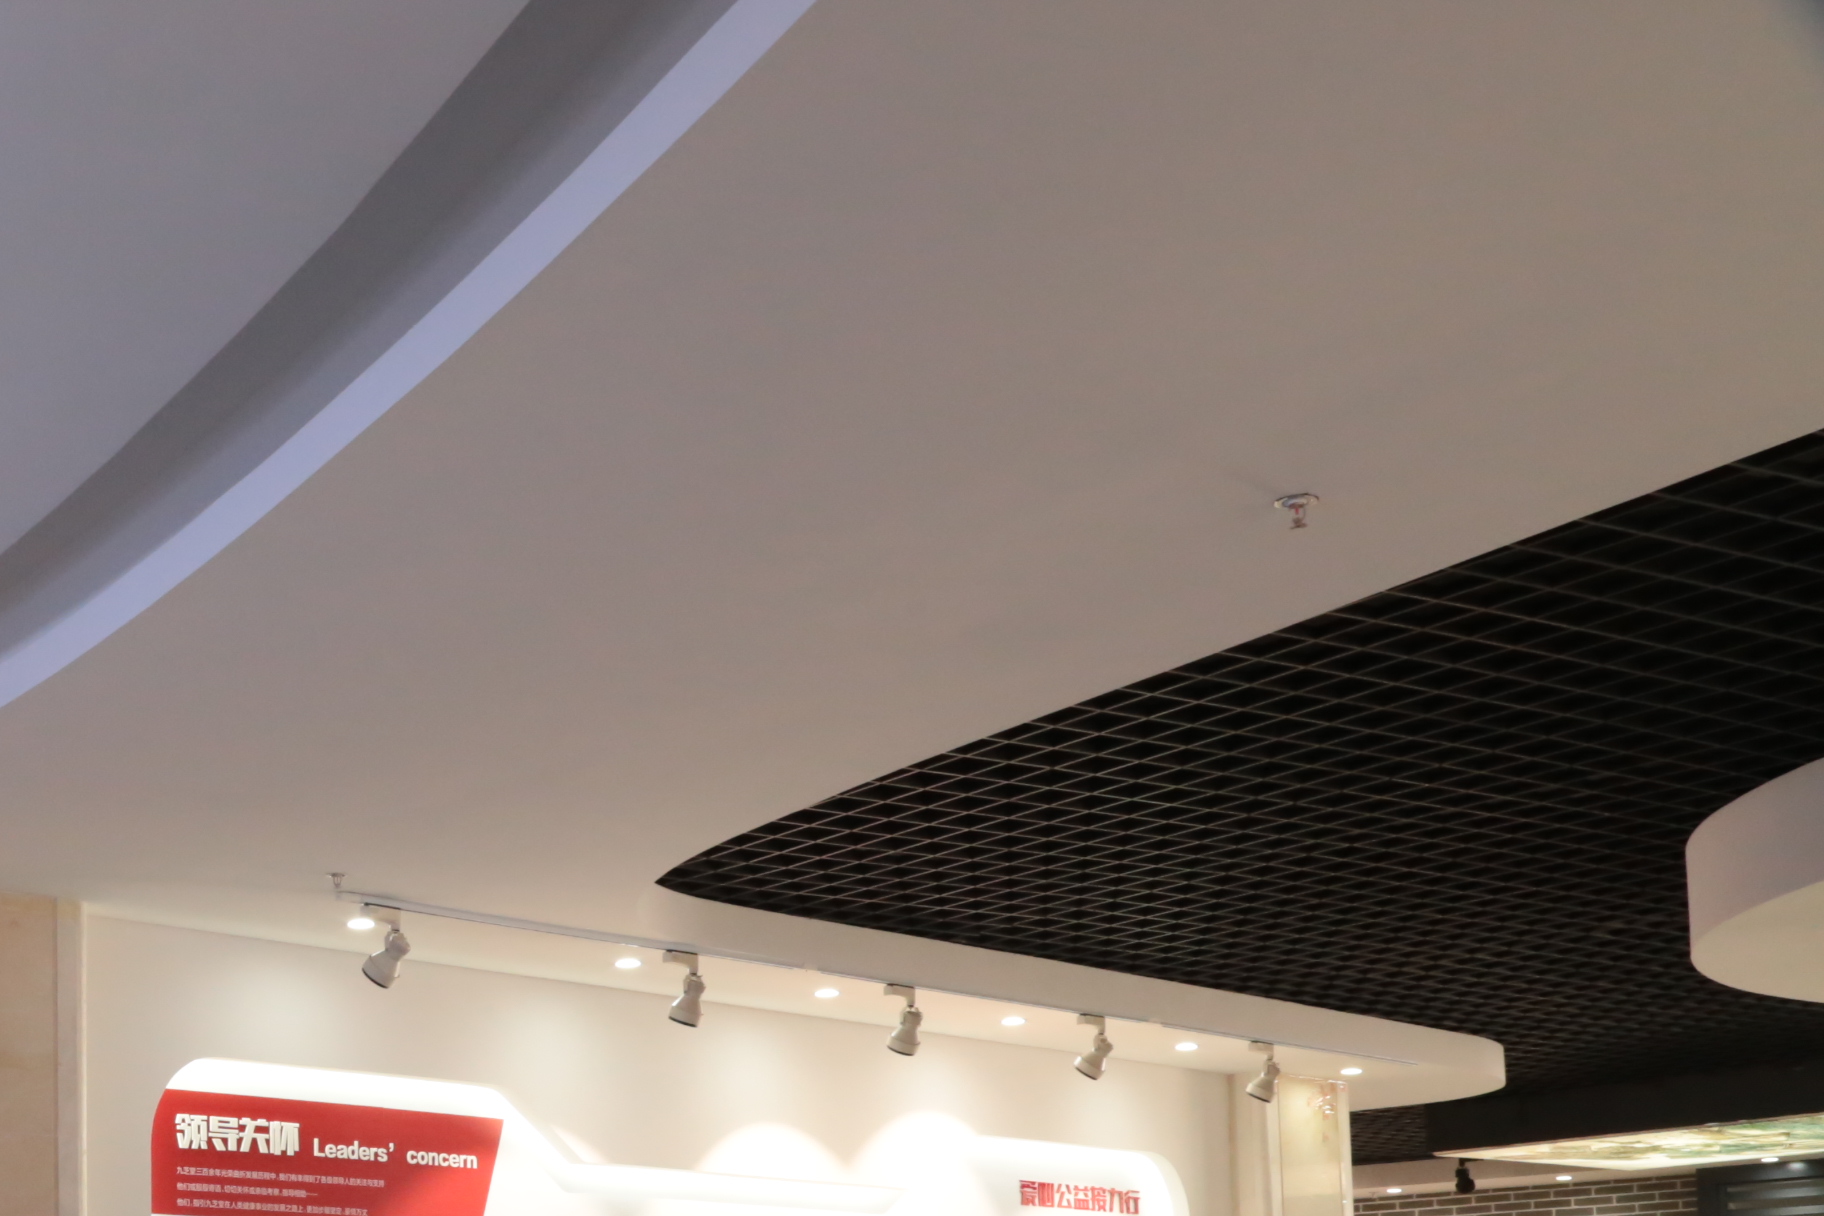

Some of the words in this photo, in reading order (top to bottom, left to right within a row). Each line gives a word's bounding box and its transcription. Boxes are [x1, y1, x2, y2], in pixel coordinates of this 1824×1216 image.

[175, 1113, 301, 1157] 领导关怀
[406, 1148, 479, 1169] concern
